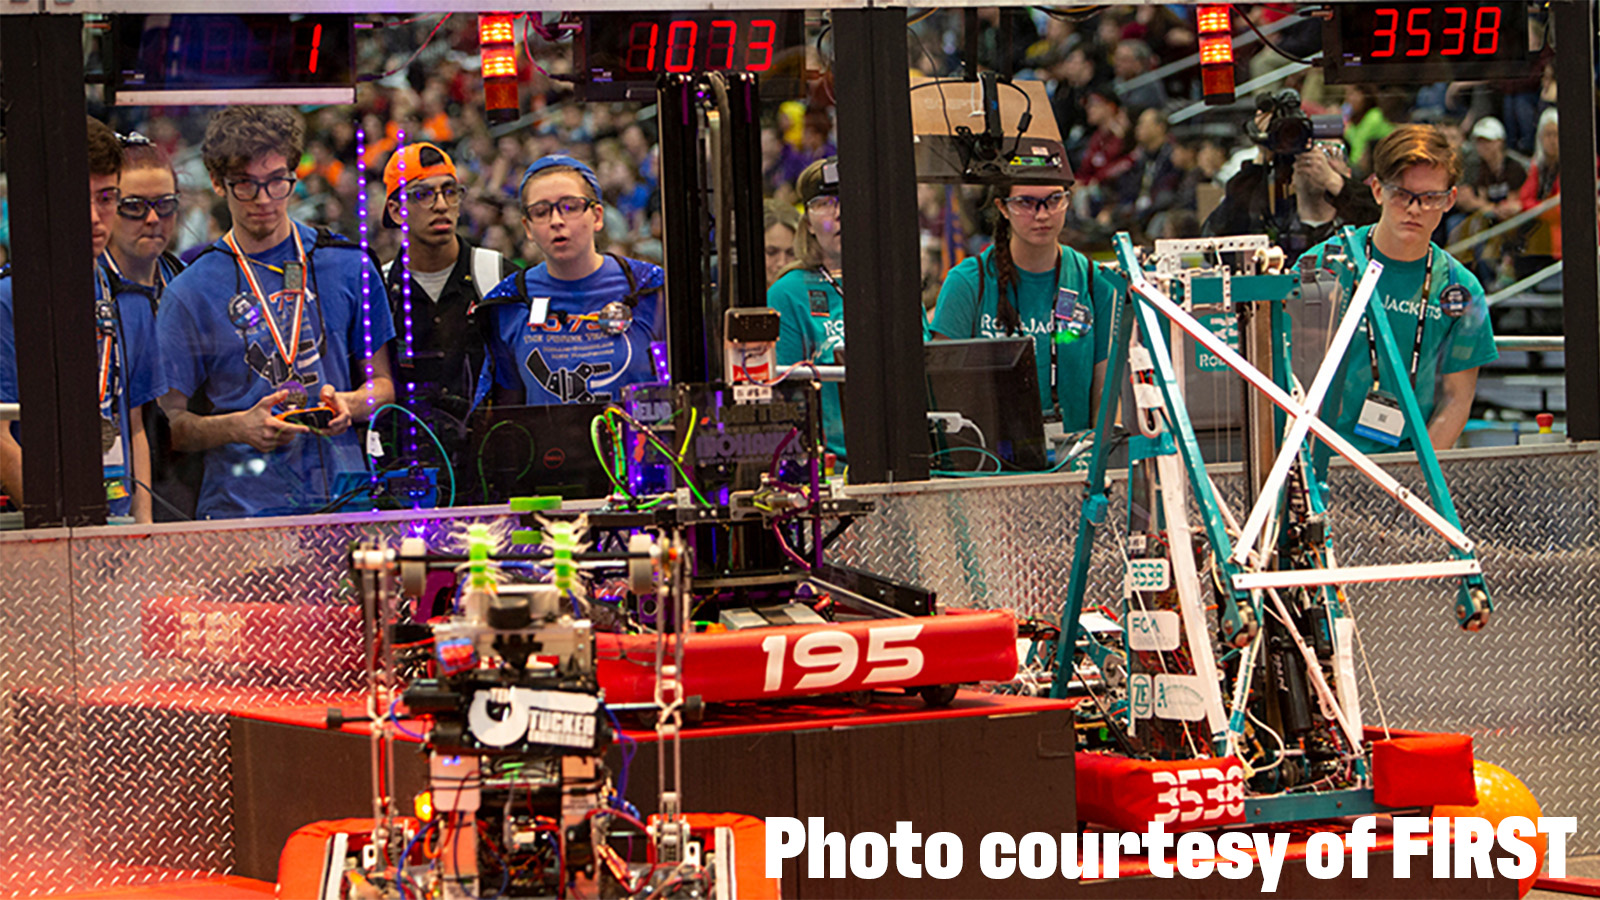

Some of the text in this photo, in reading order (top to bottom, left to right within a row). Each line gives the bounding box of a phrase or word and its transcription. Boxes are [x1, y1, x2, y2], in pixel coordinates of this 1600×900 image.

[308, 23, 322, 74] 1
[646, 19, 776, 73] 1073
[1371, 6, 1501, 57] 3538
[761, 624, 925, 692] 195
[1152, 765, 1245, 824] 3538
